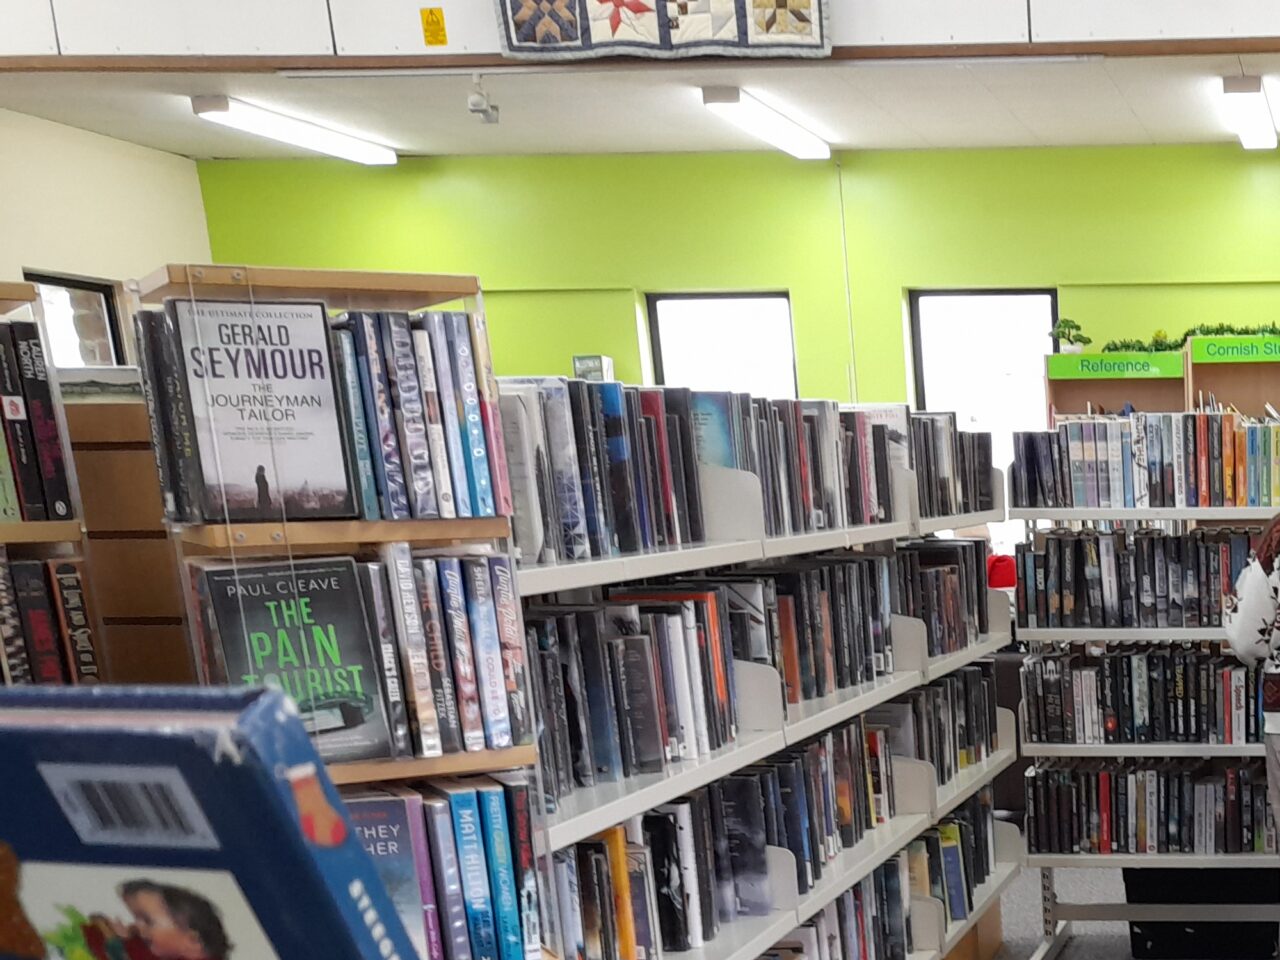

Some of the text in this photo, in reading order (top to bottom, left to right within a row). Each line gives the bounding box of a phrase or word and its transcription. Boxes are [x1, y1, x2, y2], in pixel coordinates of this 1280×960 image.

[217, 323, 290, 347] GERALD
[1205, 341, 1260, 357] Cornish
[17, 340, 35, 380] NORTH
[28, 339, 47, 381] LAUREN
[190, 346, 326, 380] SEYMOUR
[1079, 357, 1151, 374] Reference
[208, 393, 322, 408] JOURNEYMAN
[250, 383, 273, 393] THE
[237, 407, 297, 422] TAILOR
[226, 577, 341, 598] PAUL CLEAVE
[396, 559, 420, 633] DAVID HEWSON
[444, 569, 461, 608] Auntie
[472, 566, 487, 604] SHEILA
[494, 565, 511, 606] Auntie
[264, 597, 316, 628] THE
[250, 623, 342, 670] PAIN
[425, 620, 445, 672] CHILD
[434, 688, 444, 719] FITZEK
[441, 677, 458, 729] SEBASTIAN
[355, 823, 400, 839] THEY
[458, 809, 486, 910] MATT HILTON
